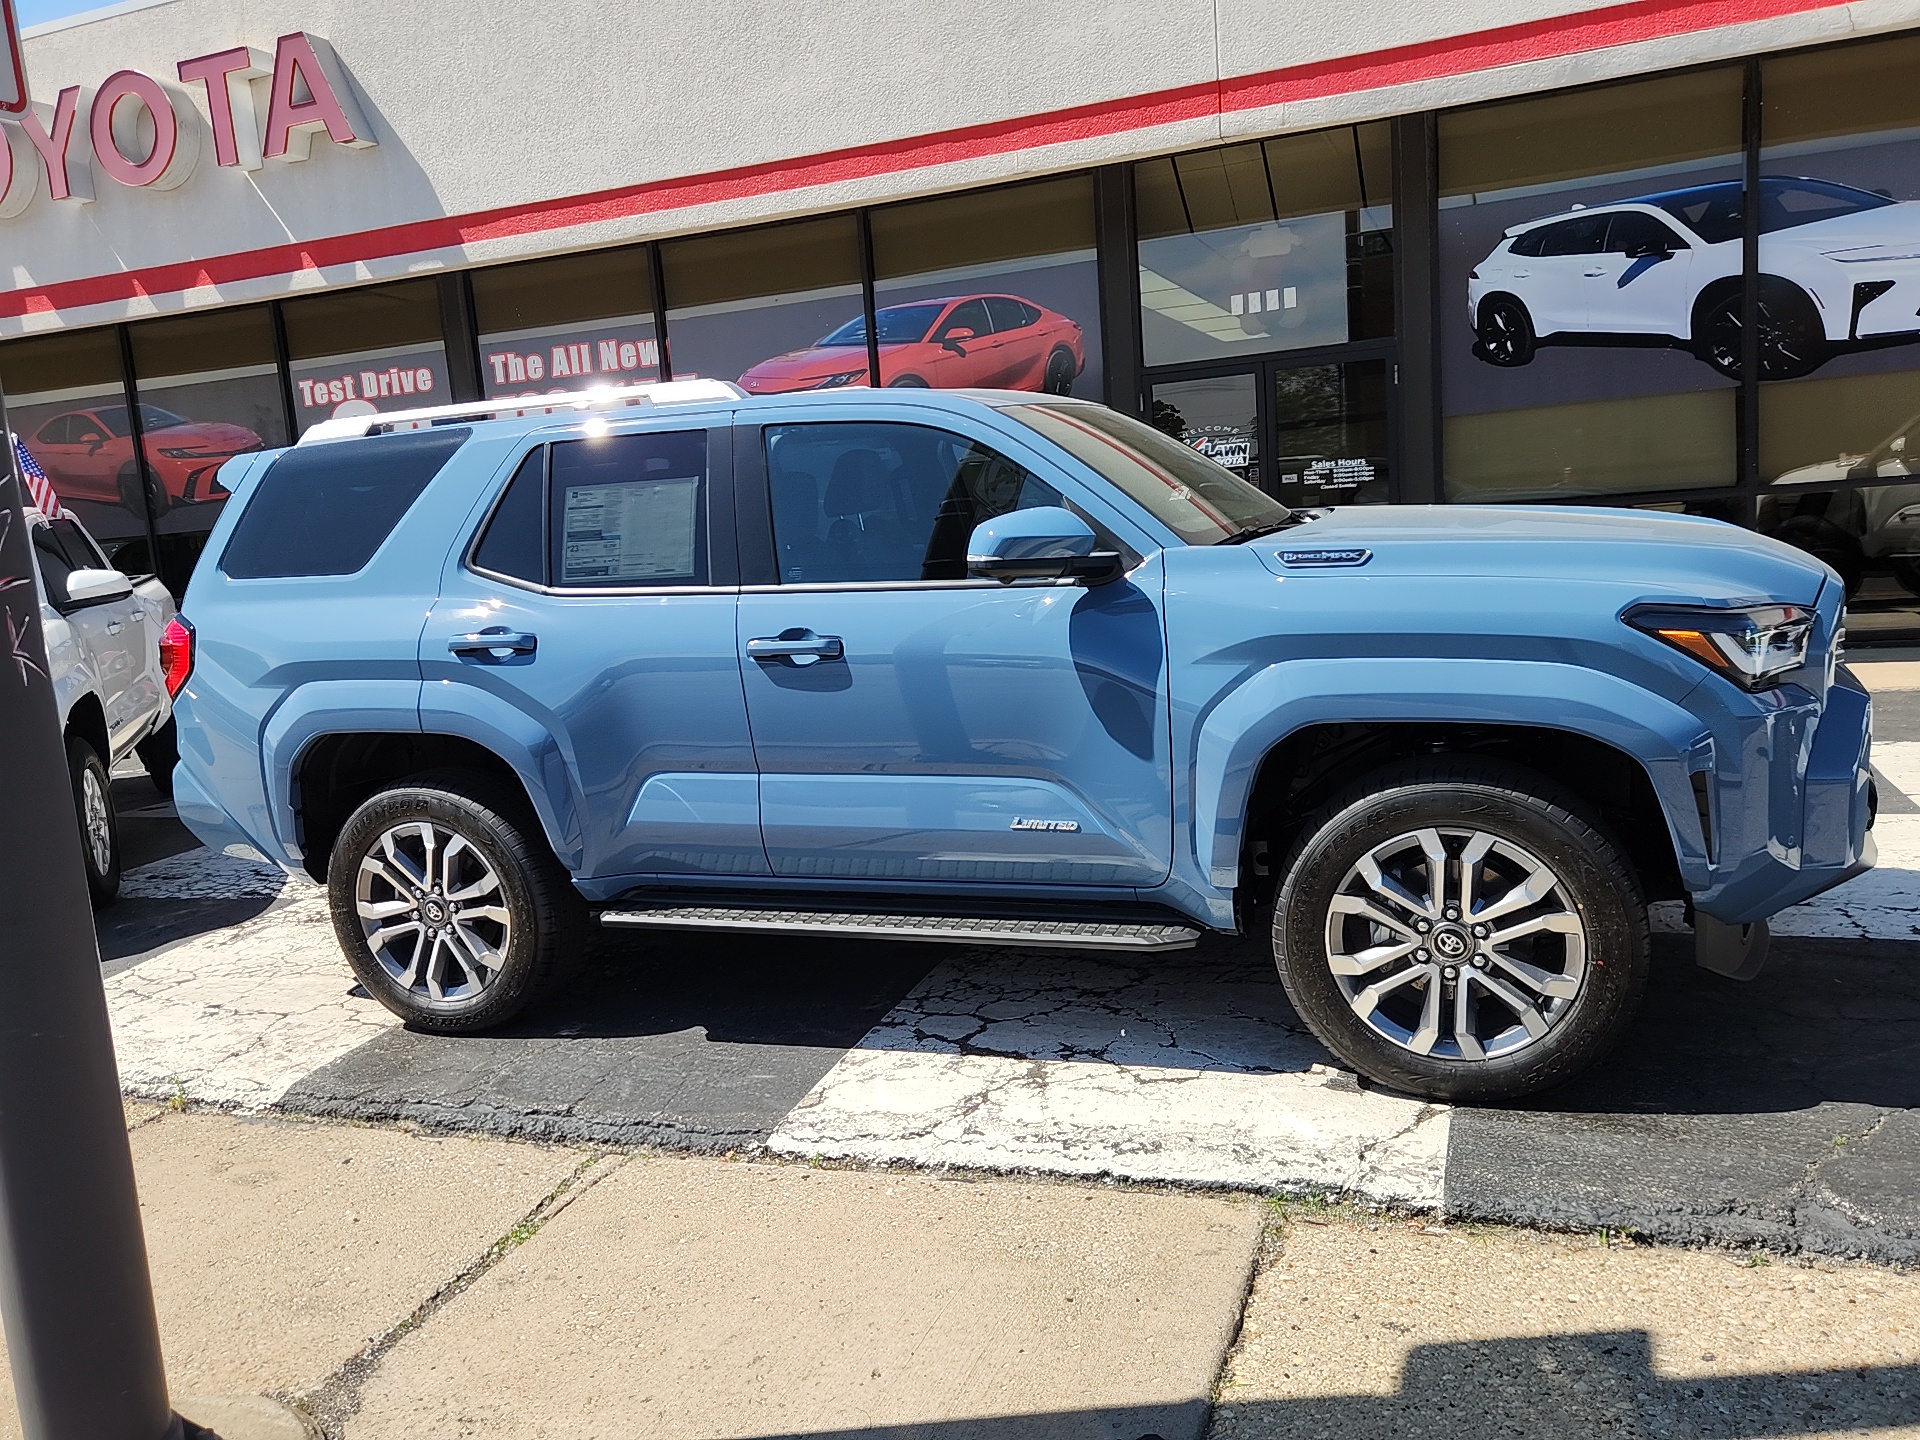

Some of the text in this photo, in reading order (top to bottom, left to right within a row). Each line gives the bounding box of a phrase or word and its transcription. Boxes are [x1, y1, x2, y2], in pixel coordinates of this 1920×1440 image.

[0, 31, 357, 202] YOTA
[489, 339, 661, 385] The All New
[299, 367, 434, 407] Test Drive
[1311, 458, 1366, 469] Sales Hours
